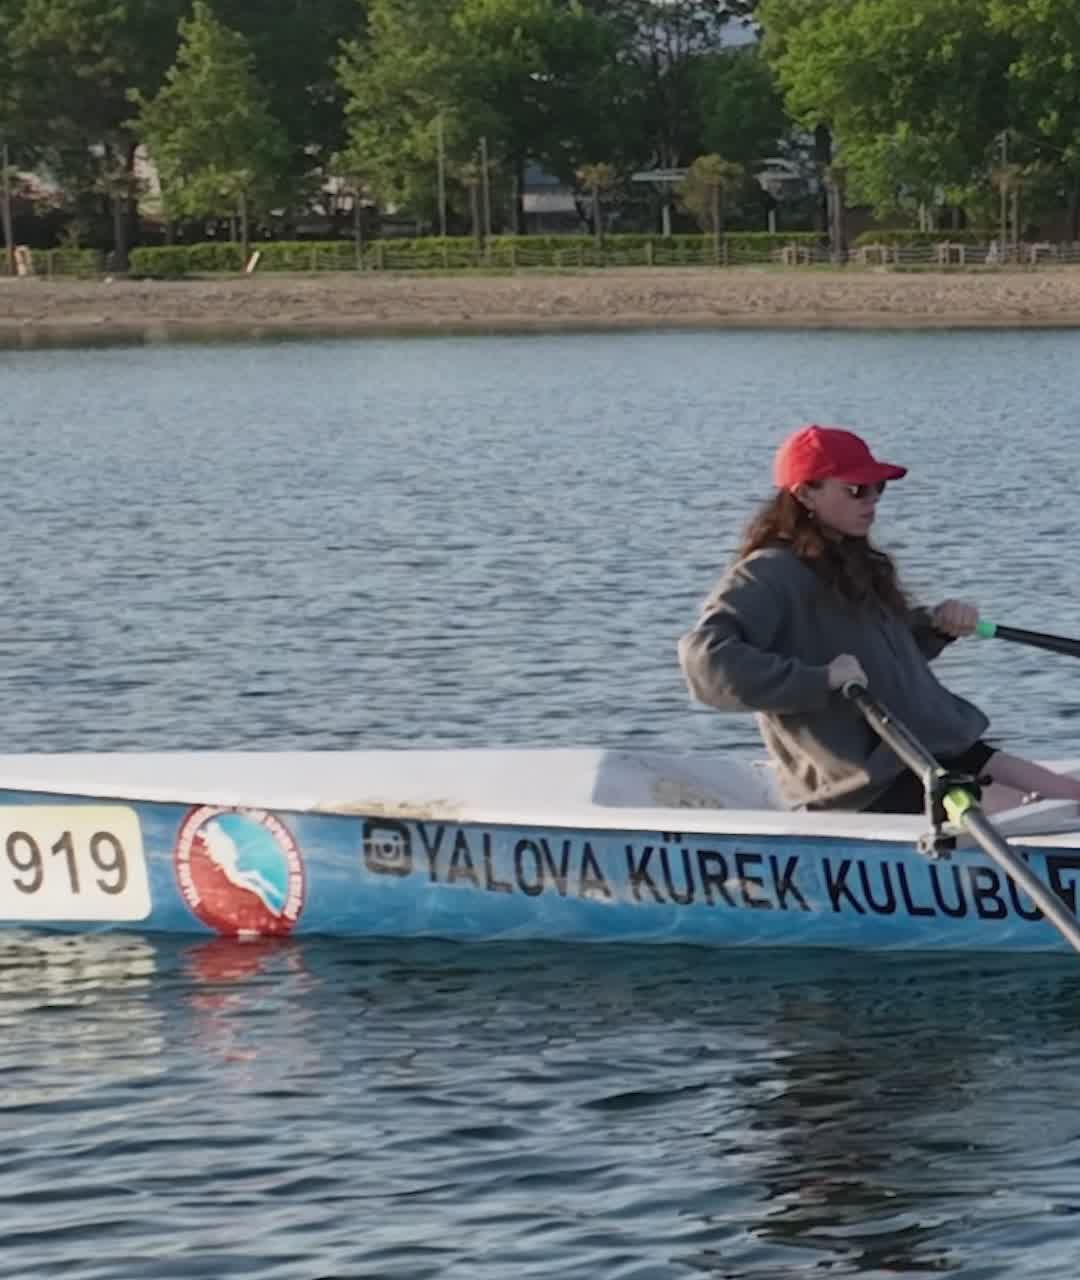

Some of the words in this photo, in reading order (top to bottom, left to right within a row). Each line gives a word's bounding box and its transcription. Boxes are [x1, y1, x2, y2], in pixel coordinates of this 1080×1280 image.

[5, 830, 128, 895] 919
[416, 824, 613, 898] YALOVA
[625, 831, 812, 912] KÜREK
